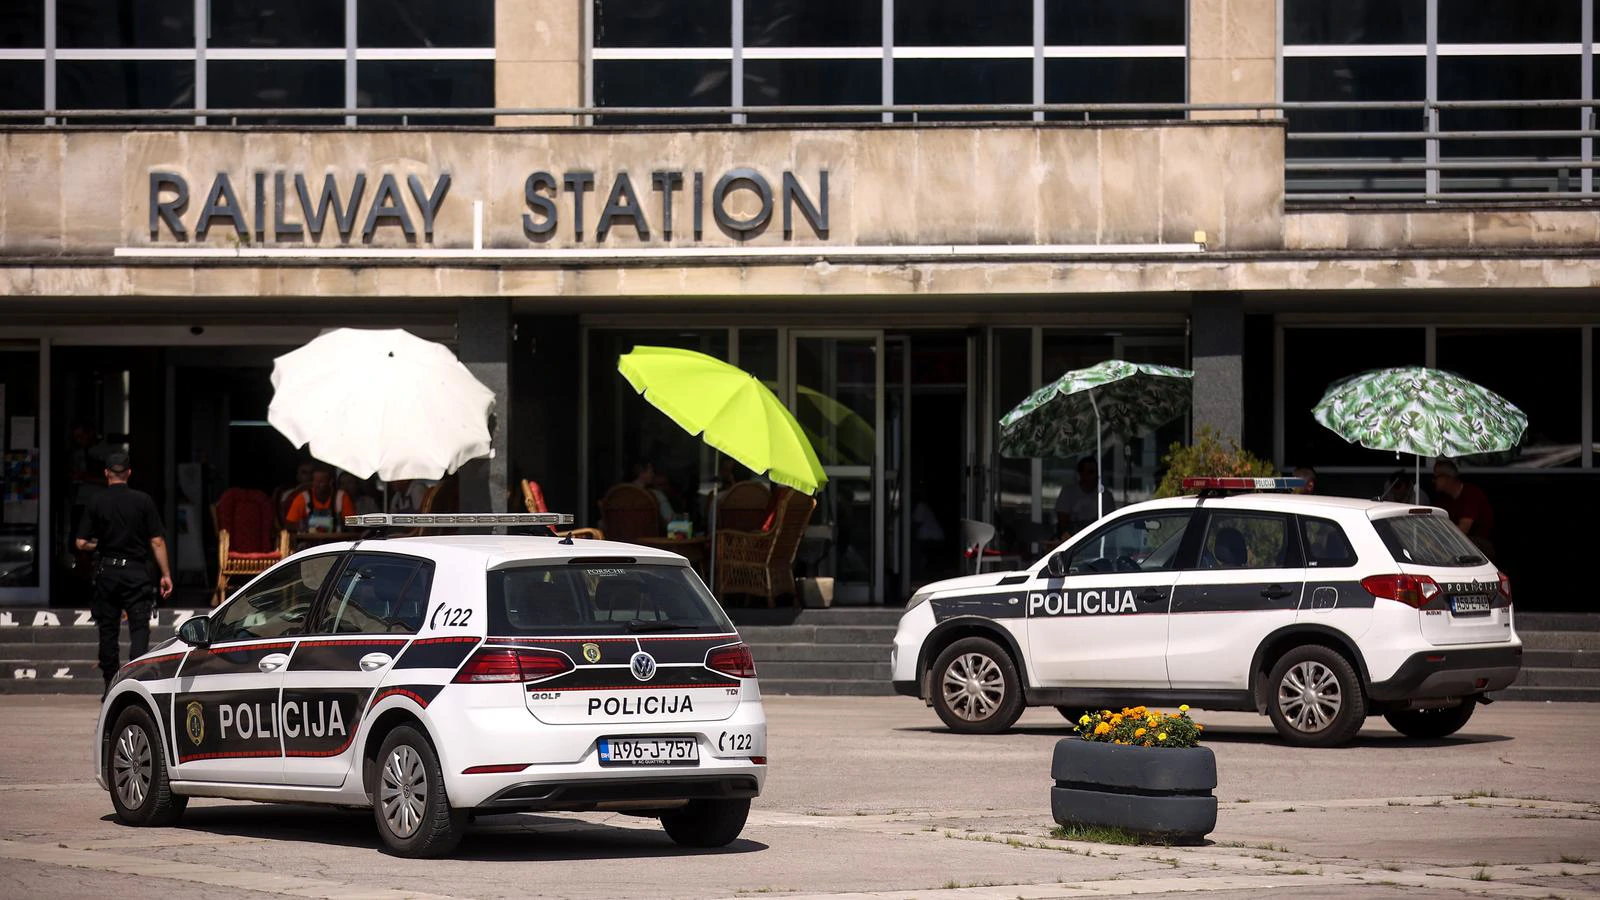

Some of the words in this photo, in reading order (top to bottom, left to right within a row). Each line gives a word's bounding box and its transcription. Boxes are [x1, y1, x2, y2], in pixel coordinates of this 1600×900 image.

[149, 170, 452, 243] RAILWAY
[522, 167, 830, 243] STATION
[1029, 590, 1138, 616] POLICIJA
[443, 608, 473, 627] 122
[531, 692, 561, 701] GOLF
[725, 688, 739, 696] TDI
[587, 694, 694, 717] POLICIJA
[219, 700, 347, 740] POLICIJA
[613, 741, 694, 760] A96-J-757
[729, 733, 752, 751] 122
